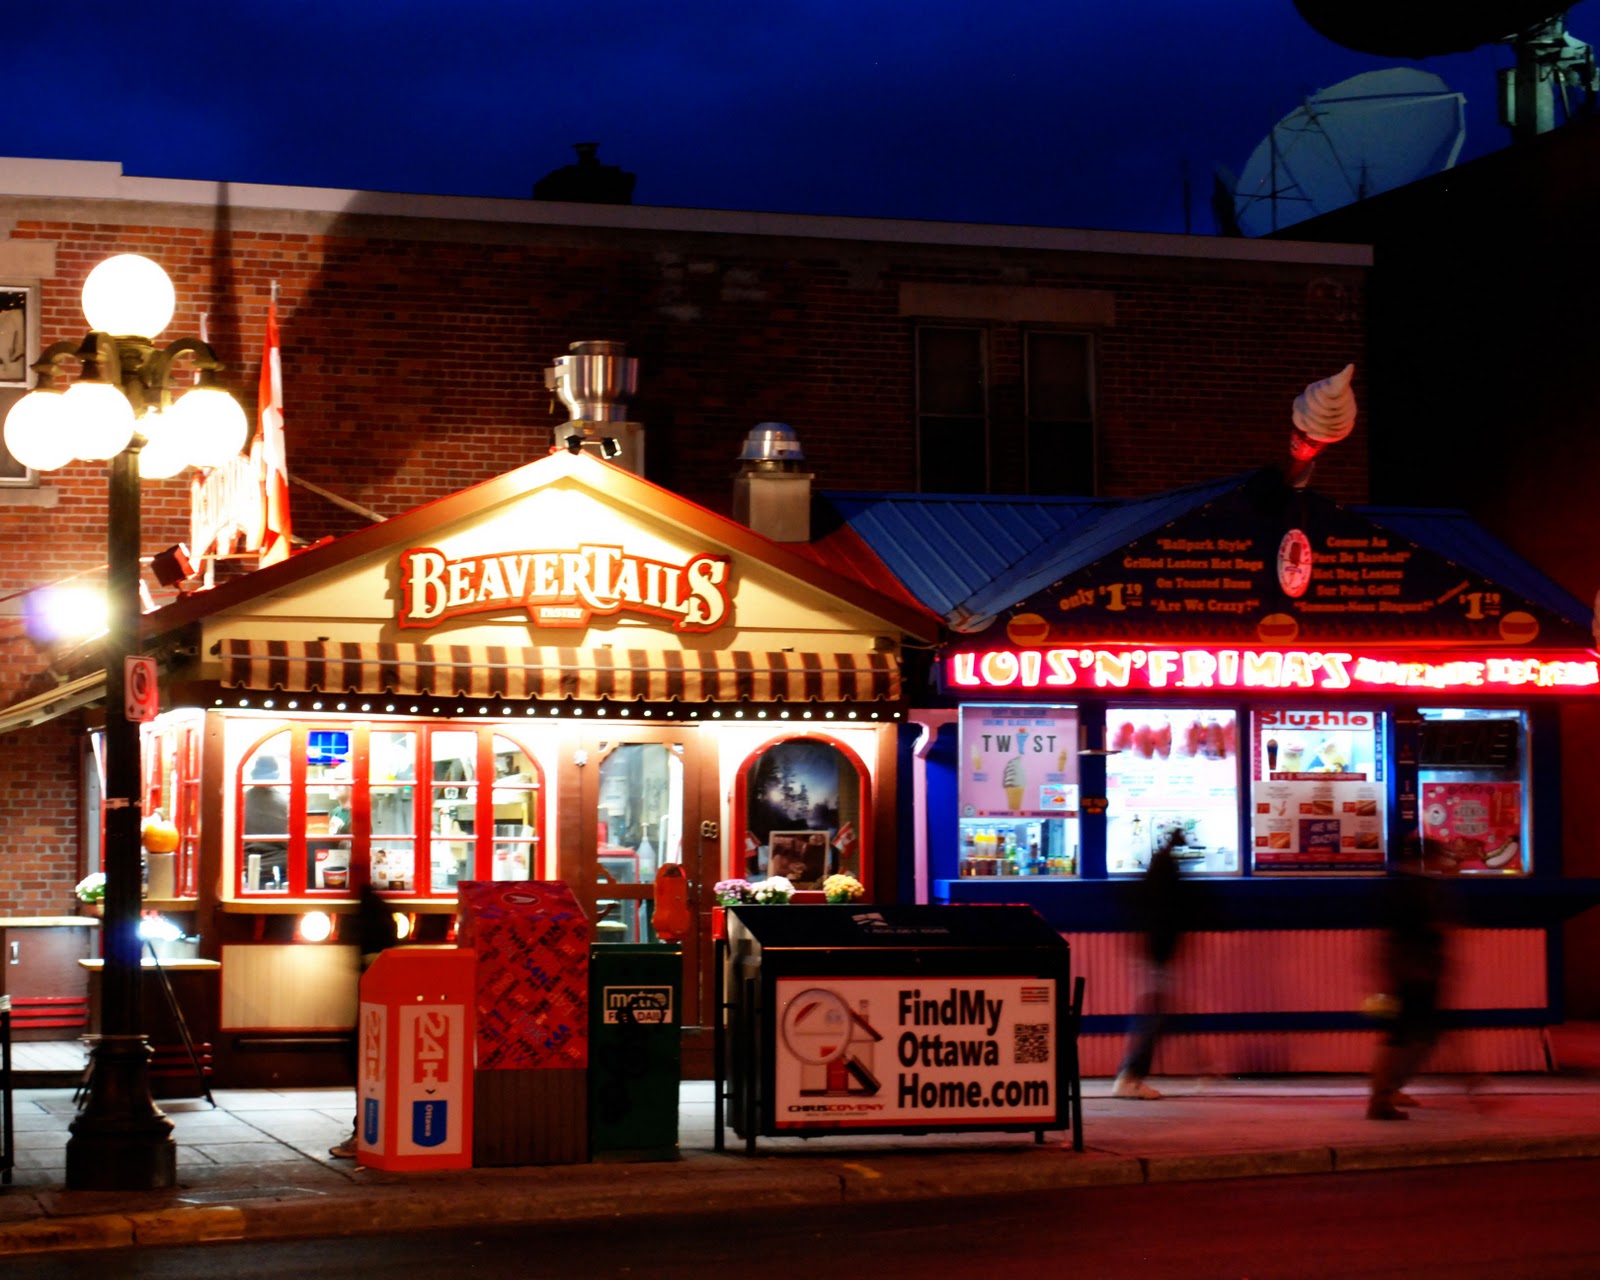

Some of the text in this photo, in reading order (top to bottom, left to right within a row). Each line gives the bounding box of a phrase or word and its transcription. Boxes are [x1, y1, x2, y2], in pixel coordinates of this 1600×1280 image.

[1123, 557, 1165, 569] Grilled
[1211, 558, 1233, 569] Hot
[1175, 577, 1220, 589] Toasted
[1058, 588, 1096, 612] only
[1183, 599, 1206, 612] We
[700, 820, 719, 839] 69
[898, 989, 1003, 1036] FindMy
[415, 1013, 448, 1083] 24H
[898, 1032, 998, 1067] Ottawa
[898, 1073, 1049, 1109] Home.com
